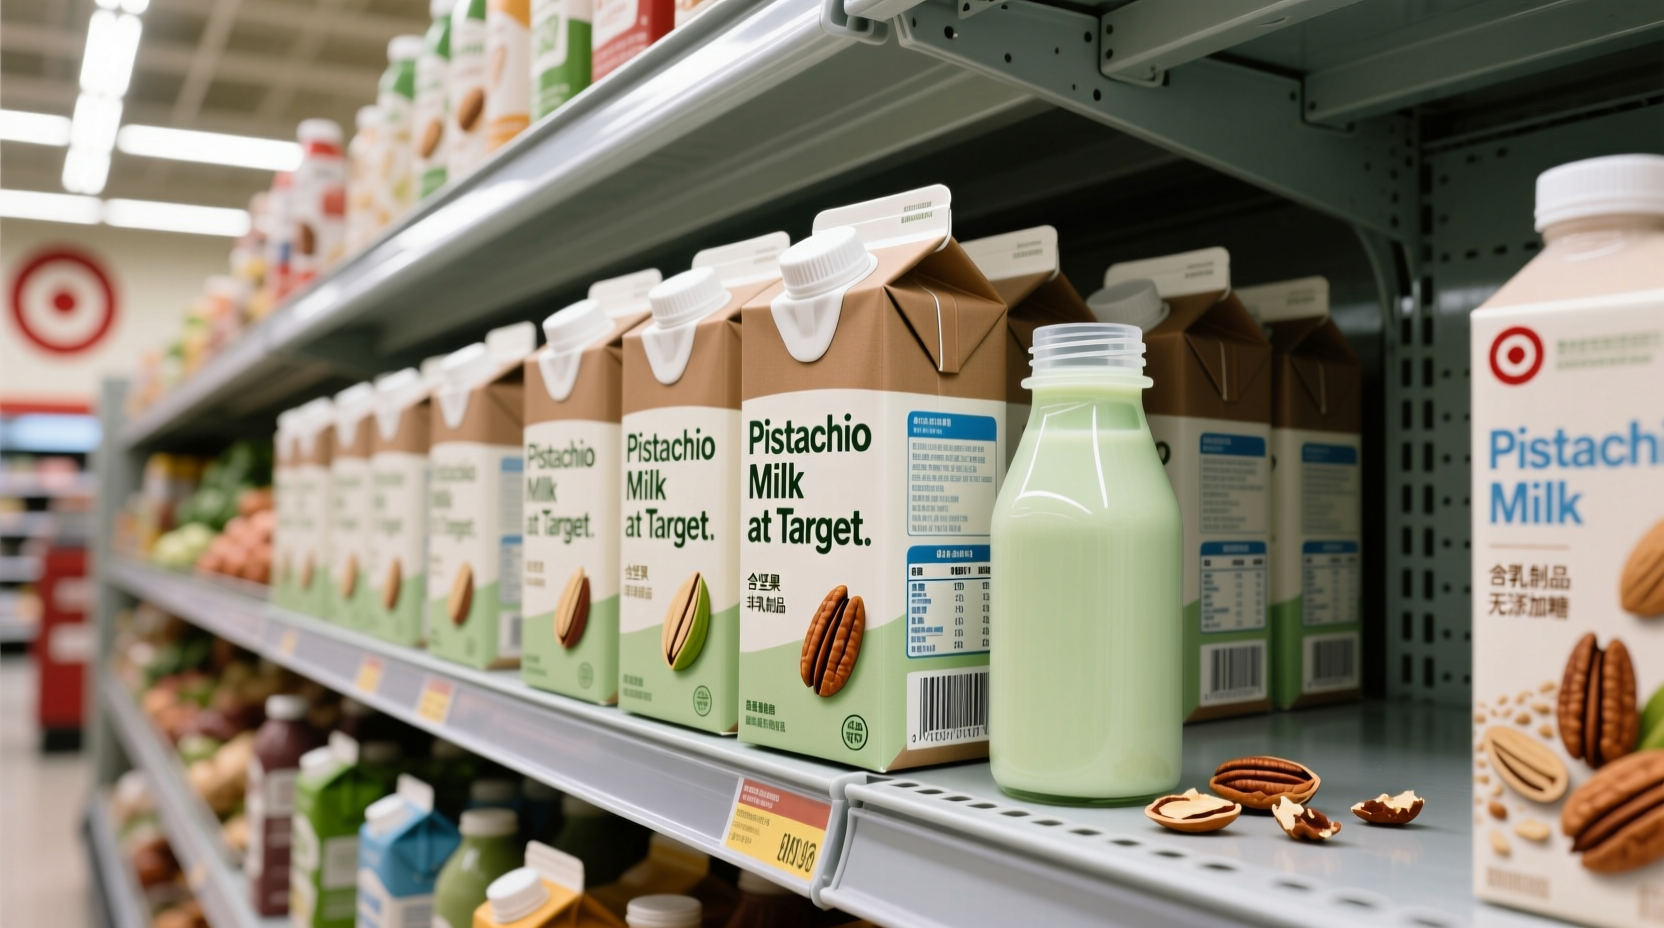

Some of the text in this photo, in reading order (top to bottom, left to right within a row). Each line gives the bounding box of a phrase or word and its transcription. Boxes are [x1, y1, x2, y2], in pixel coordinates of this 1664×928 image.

[626, 427, 716, 463] Pistachio
[748, 413, 872, 455] Pistachio
[1489, 420, 1664, 470] Pistach
[527, 439, 597, 470] Pistachio
[527, 475, 558, 503] Milk
[626, 468, 667, 501] Milk
[749, 461, 805, 500] Milk
[1490, 480, 1583, 526] Milk
[541, 508, 596, 545] Target.
[625, 508, 715, 549] at Target.
[747, 507, 872, 555] at Target.
